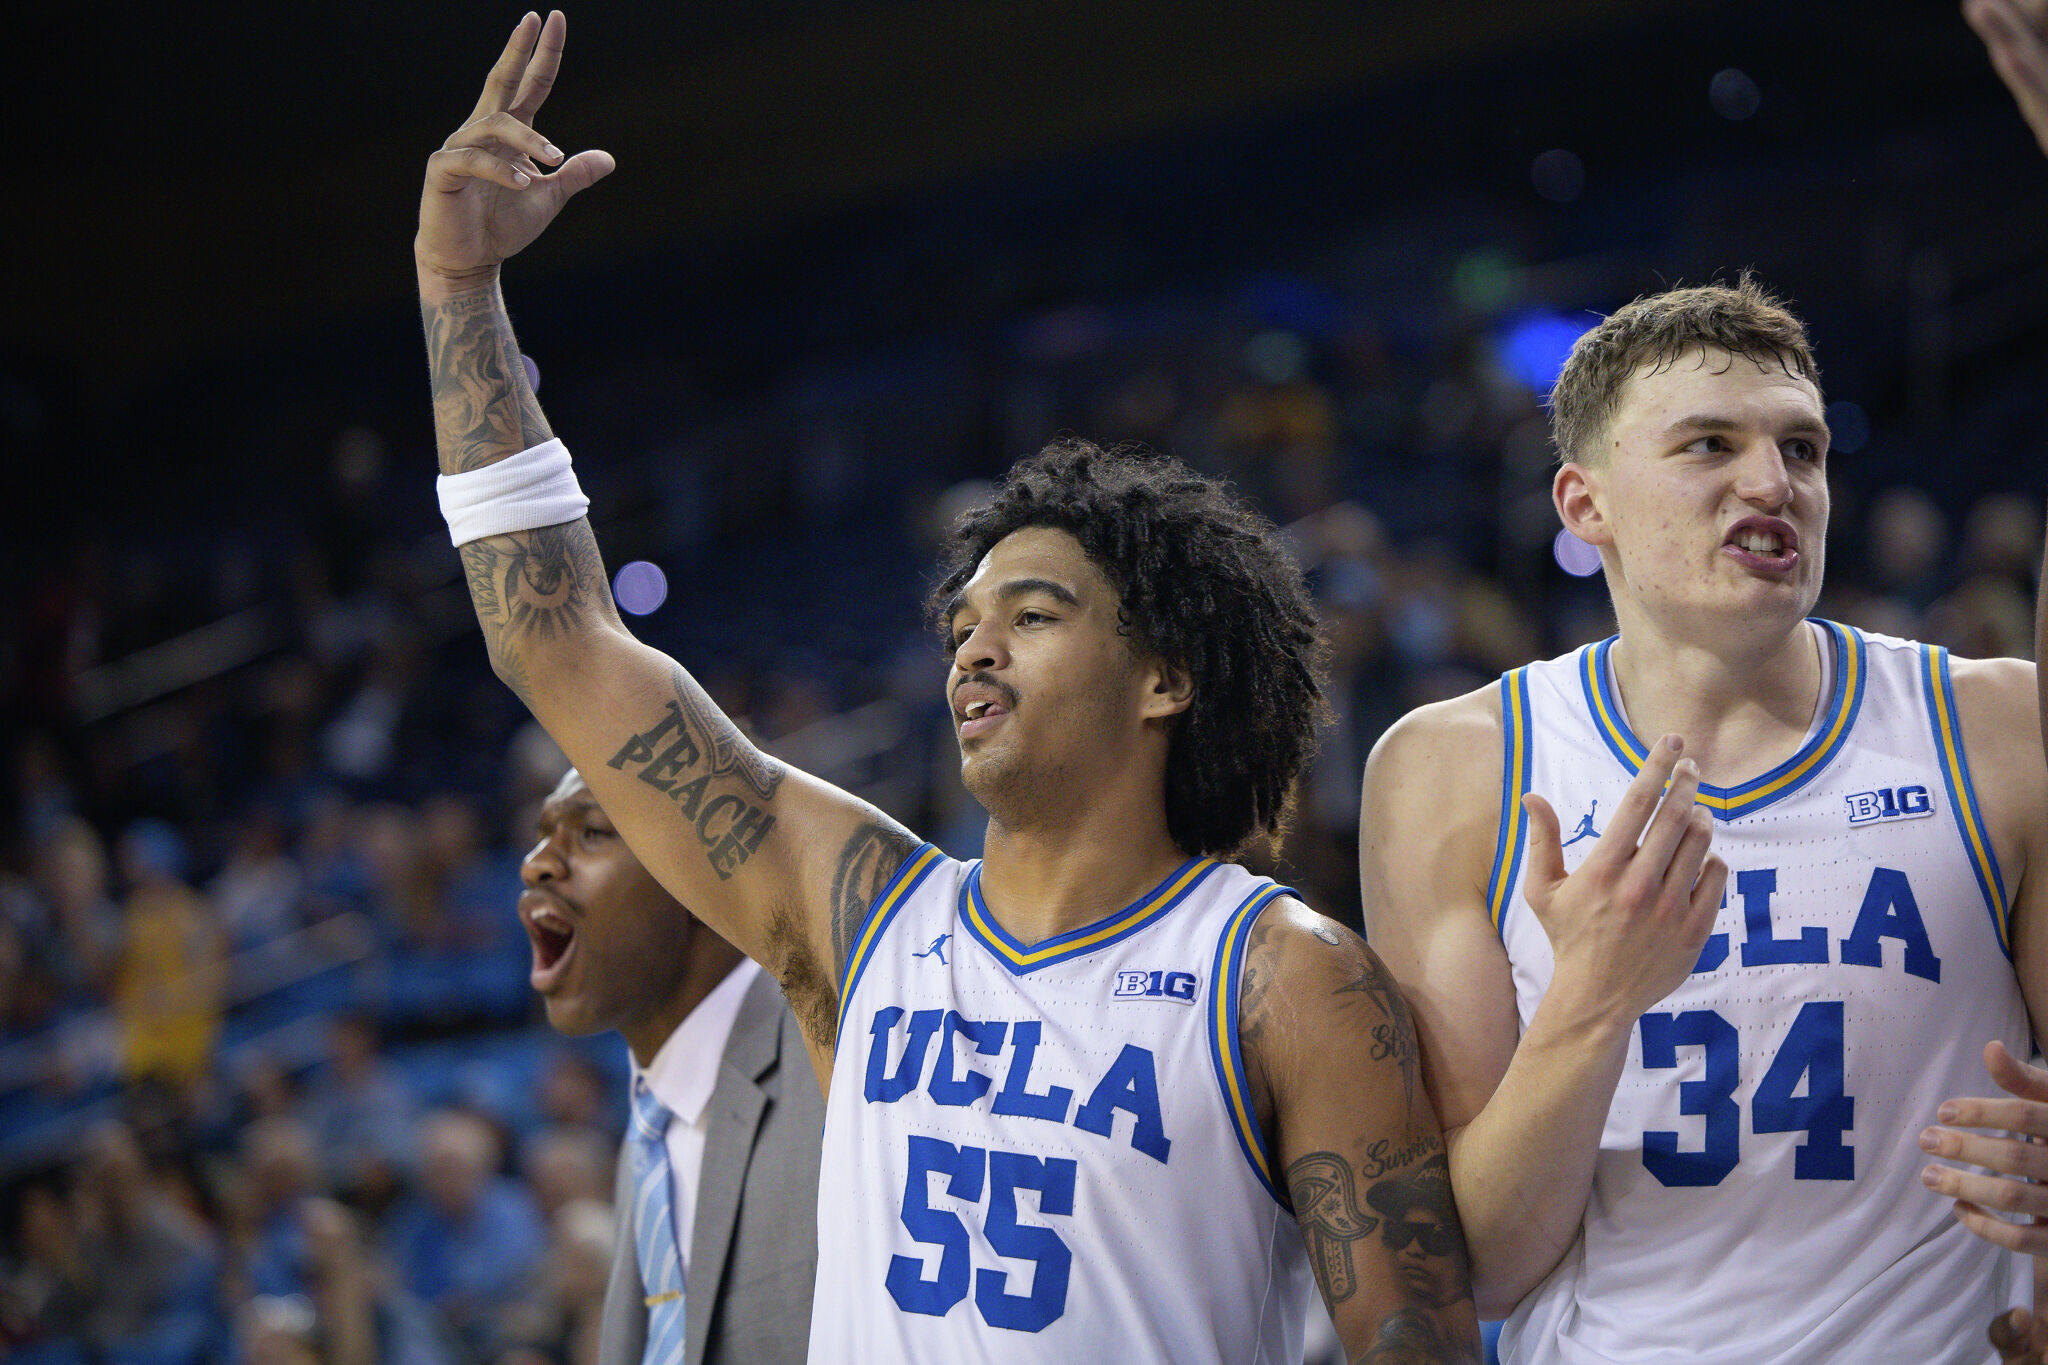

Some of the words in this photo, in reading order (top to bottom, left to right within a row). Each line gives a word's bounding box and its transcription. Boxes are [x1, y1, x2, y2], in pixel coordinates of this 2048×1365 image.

[1691, 866, 1941, 984] LA
[864, 1005, 1172, 1165] UCLA
[1639, 1001, 1855, 1187] 34
[885, 1134, 1078, 1334] 55
